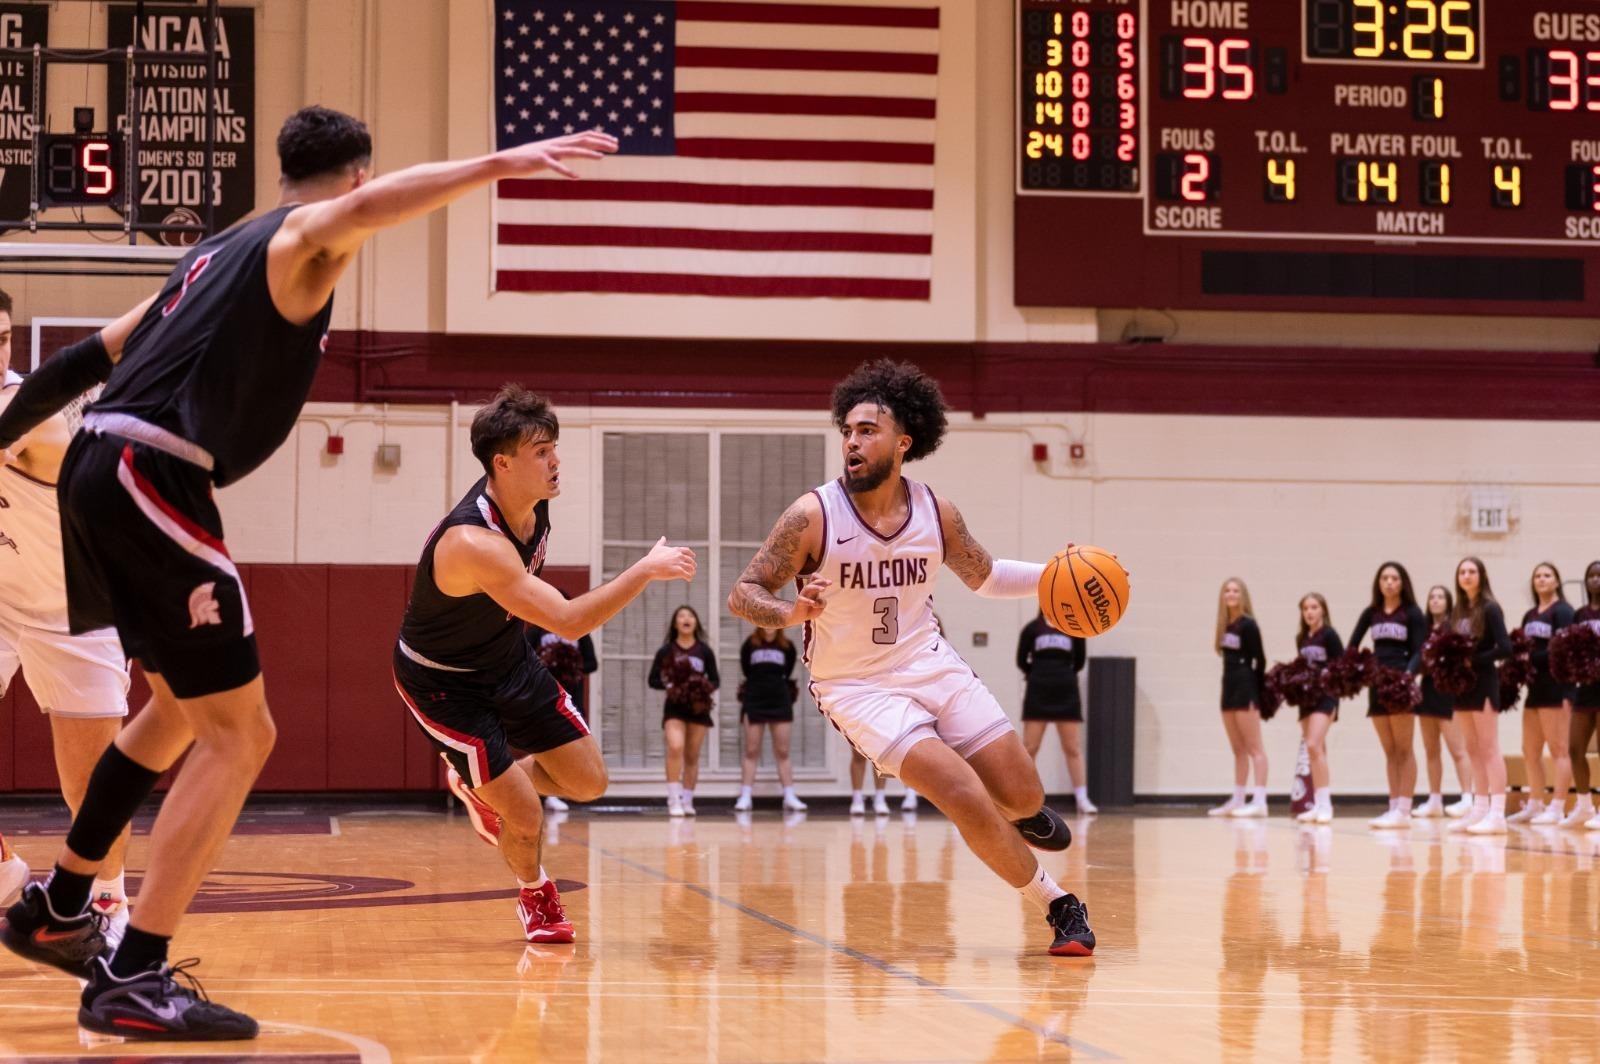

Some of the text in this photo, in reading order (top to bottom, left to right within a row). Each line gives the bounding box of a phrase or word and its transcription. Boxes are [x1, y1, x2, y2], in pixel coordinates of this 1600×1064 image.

[1053, 11, 1135, 39] 1 0 0
[1171, 1, 1248, 29] HOME
[1533, 12, 1600, 41] GUES
[1352, 0, 1475, 60] 3:25
[1046, 39, 1135, 69] 3 0 5
[1183, 38, 1253, 99] 35
[1035, 71, 1135, 100] 10 0 6
[1334, 84, 1407, 107] PERIOD
[1433, 78, 1443, 118] 1
[1035, 101, 1135, 129] 14 0 3
[1026, 131, 1135, 161] 24 0 2
[1161, 128, 1215, 150] FOULS
[1255, 131, 1307, 153] T.O.L.
[1330, 133, 1462, 157] PLAYER FOUL
[1481, 137, 1532, 160] T.O.L.
[83, 143, 112, 194] 5
[1181, 154, 1209, 201] 2
[1267, 159, 1295, 200] 4
[1358, 162, 1450, 204] 14 1
[1494, 166, 1521, 206] 4
[1155, 206, 1222, 229] SCORE
[1376, 211, 1444, 234] MATCH
[1478, 508, 1503, 528] EXIT
[840, 557, 928, 589] FALCONS
[1083, 575, 1112, 631] Wilson
[872, 596, 899, 645] 3
